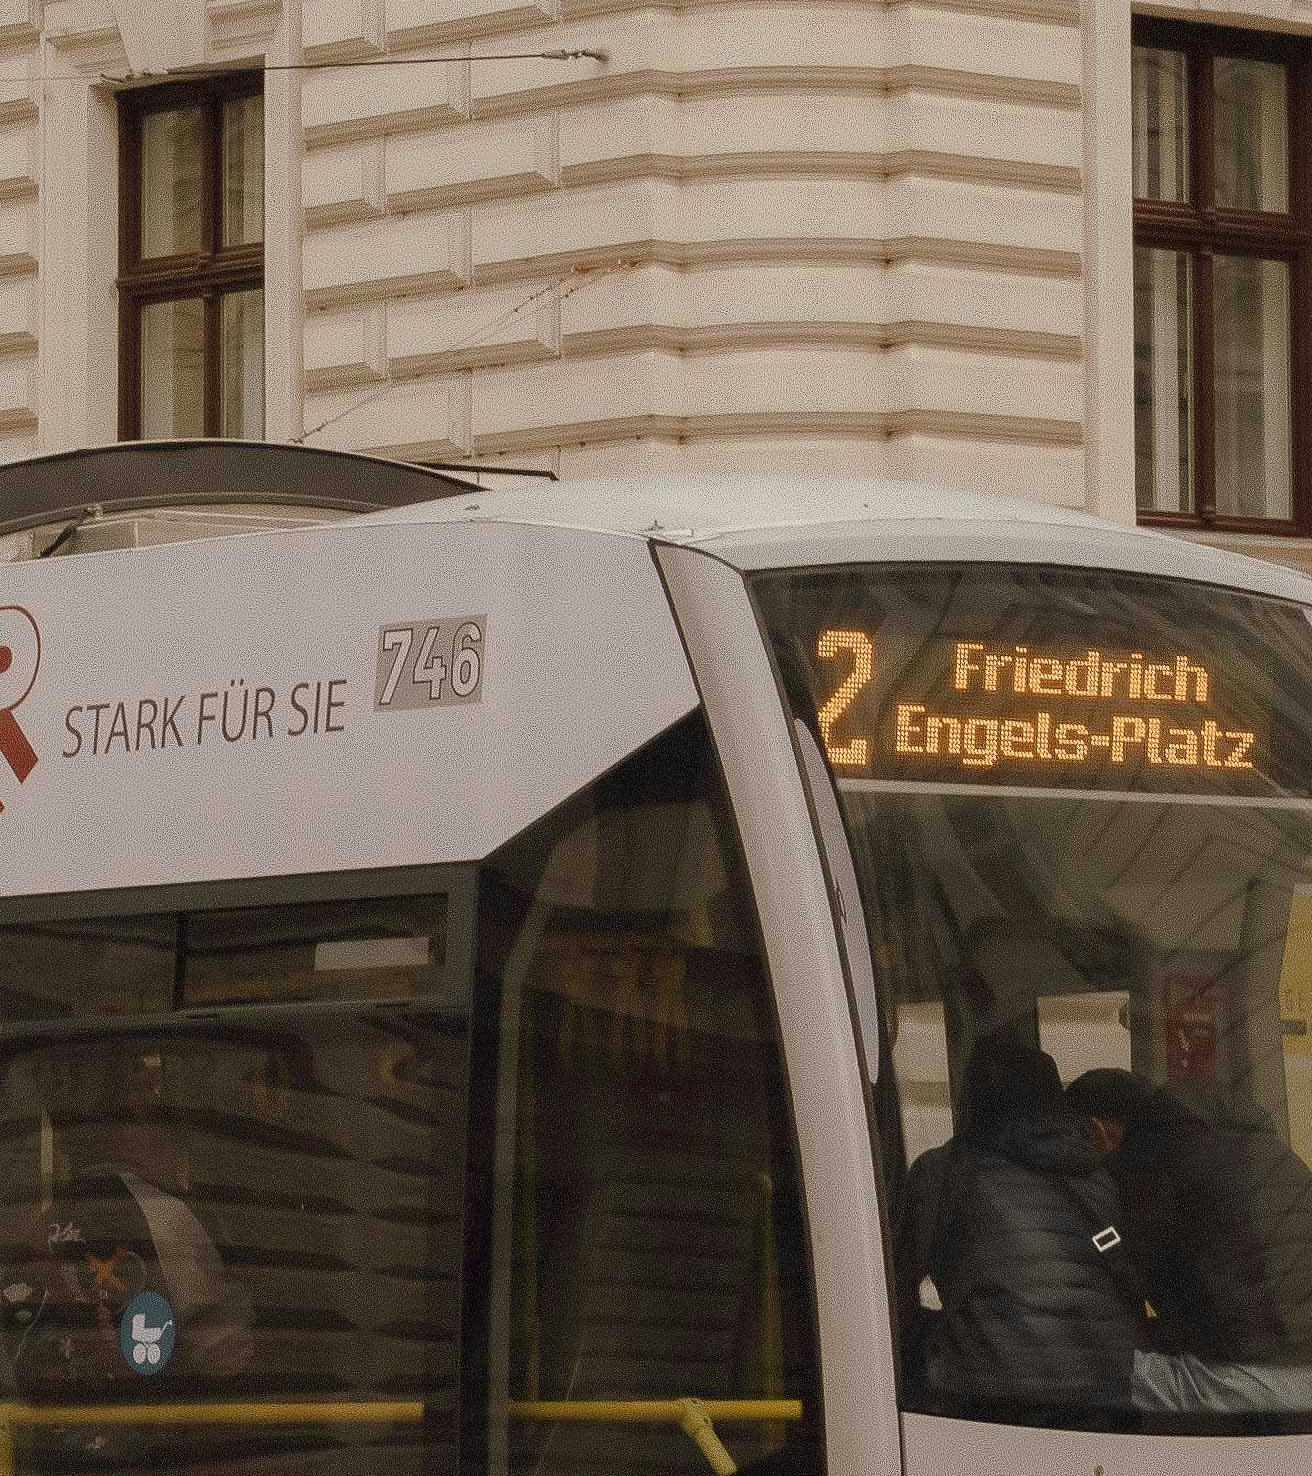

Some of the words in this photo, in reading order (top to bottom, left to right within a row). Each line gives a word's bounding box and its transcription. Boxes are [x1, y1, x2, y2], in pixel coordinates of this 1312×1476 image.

[378, 621, 483, 707] 746
[817, 629, 874, 766] 2
[953, 642, 1210, 704] Friedrich
[61, 694, 185, 759] STARK
[197, 679, 275, 746] FÜR
[287, 678, 348, 737] SIE
[895, 703, 1256, 769] Engels-Platz
